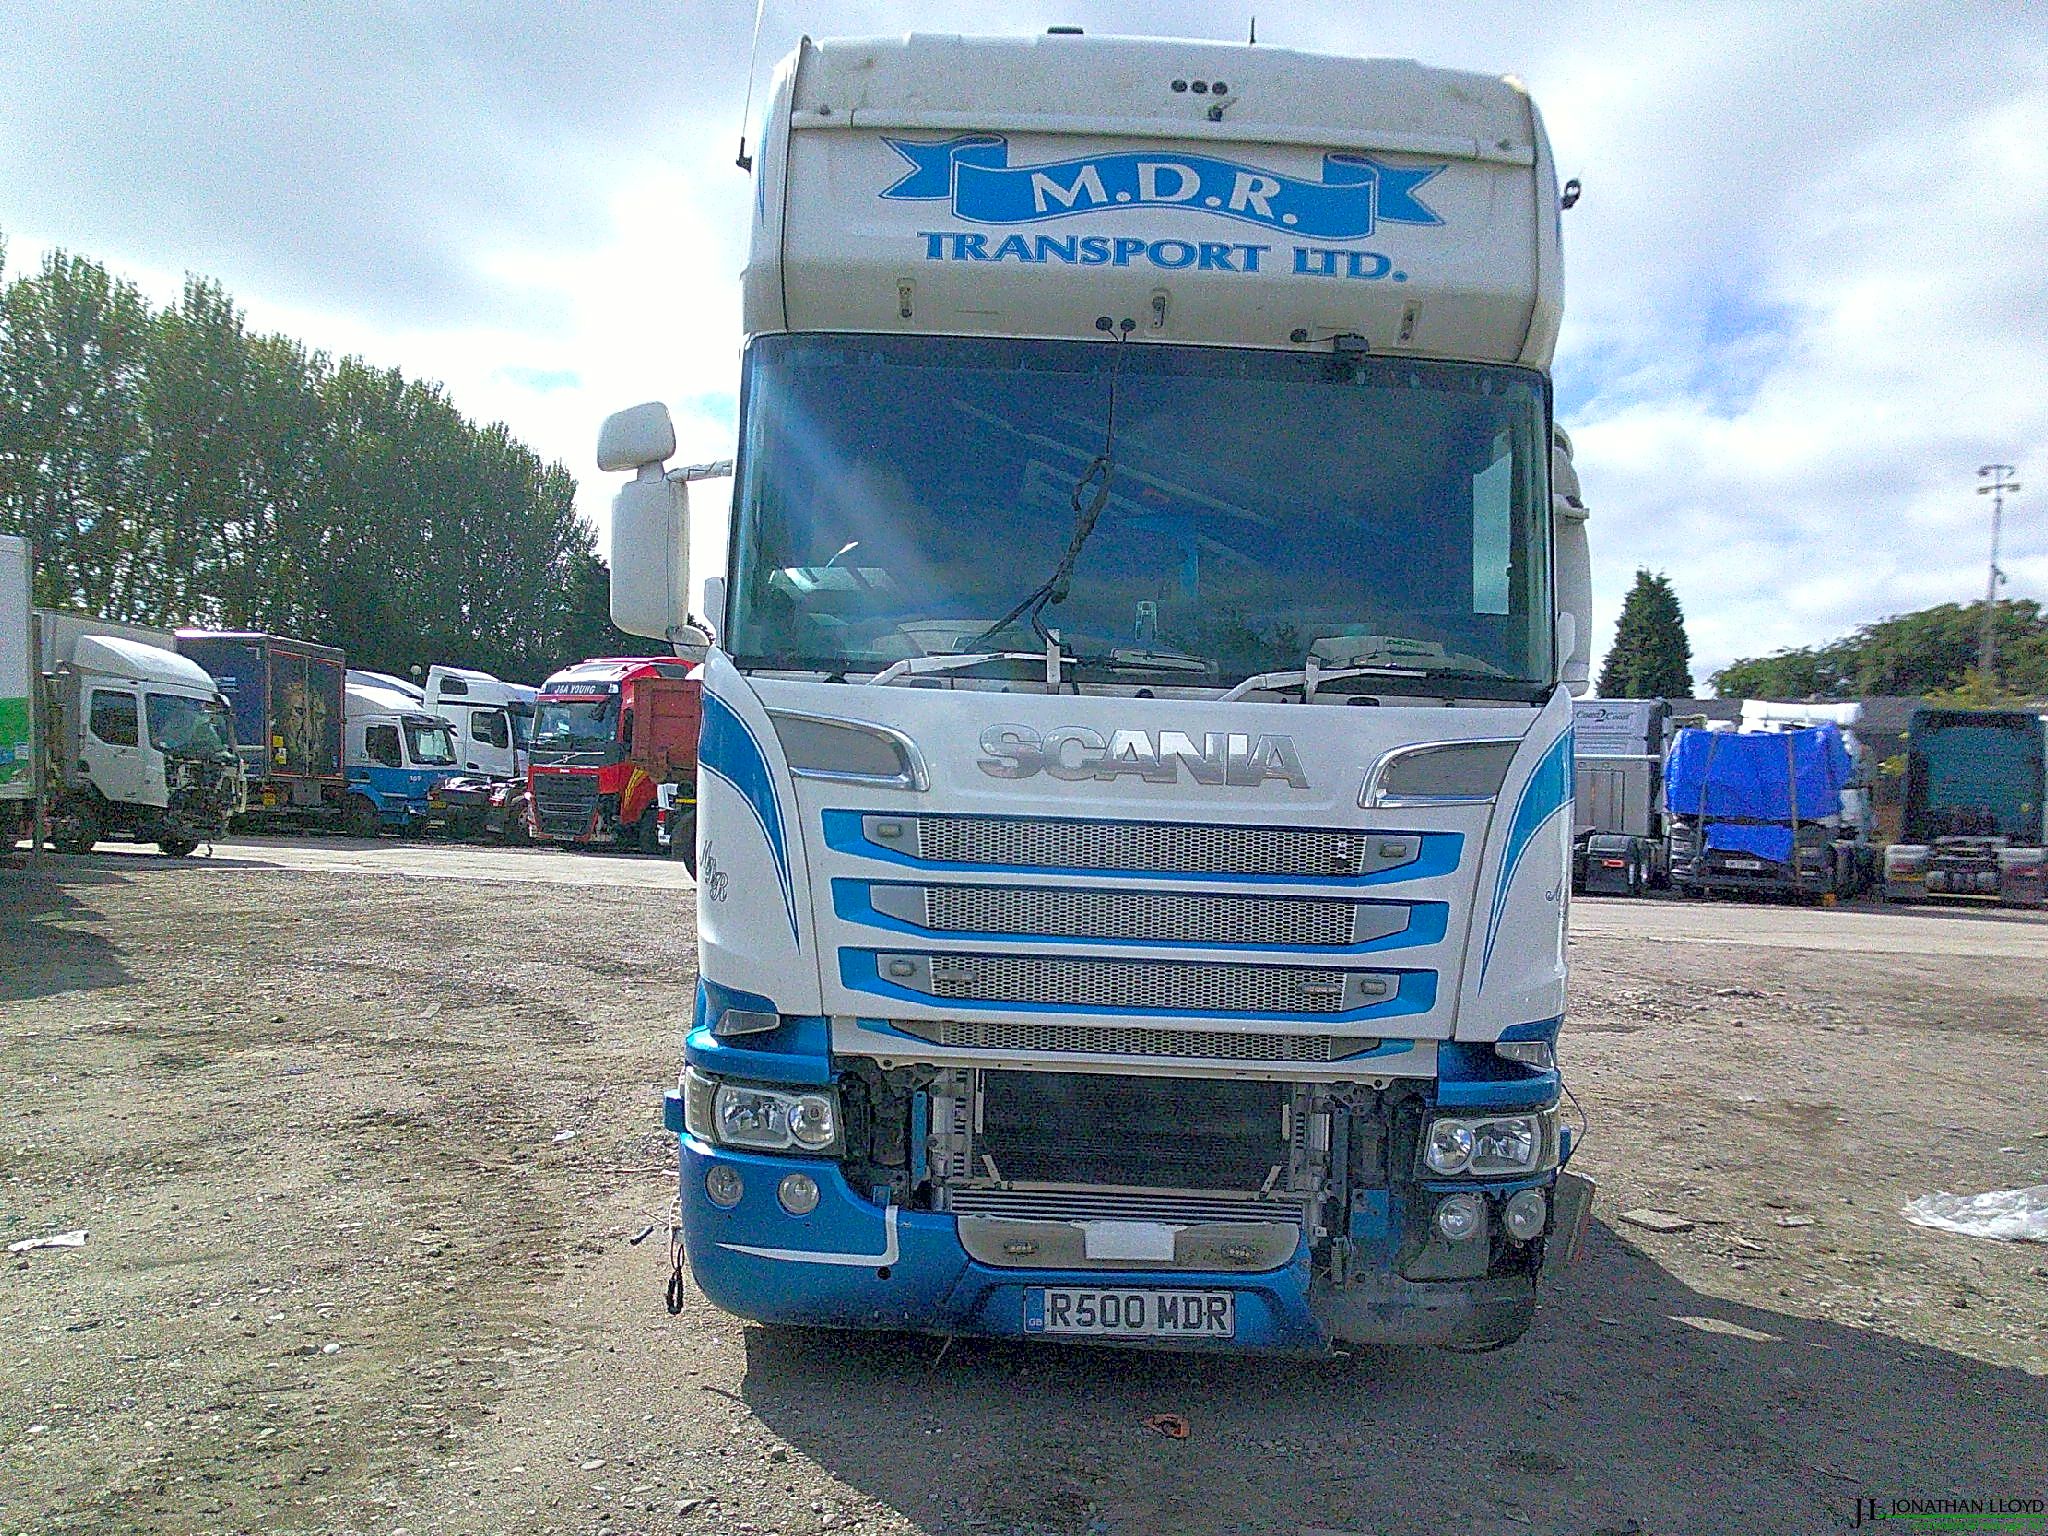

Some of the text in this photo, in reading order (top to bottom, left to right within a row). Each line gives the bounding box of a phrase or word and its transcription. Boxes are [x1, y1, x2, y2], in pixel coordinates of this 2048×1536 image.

[1031, 161, 1300, 225] M.D.R.
[917, 231, 1409, 283] TRANSPORT LTD.
[570, 684, 596, 694] YOUNG
[976, 722, 1311, 789] SCANIA
[1049, 1292, 1228, 1330] R500 MDR
